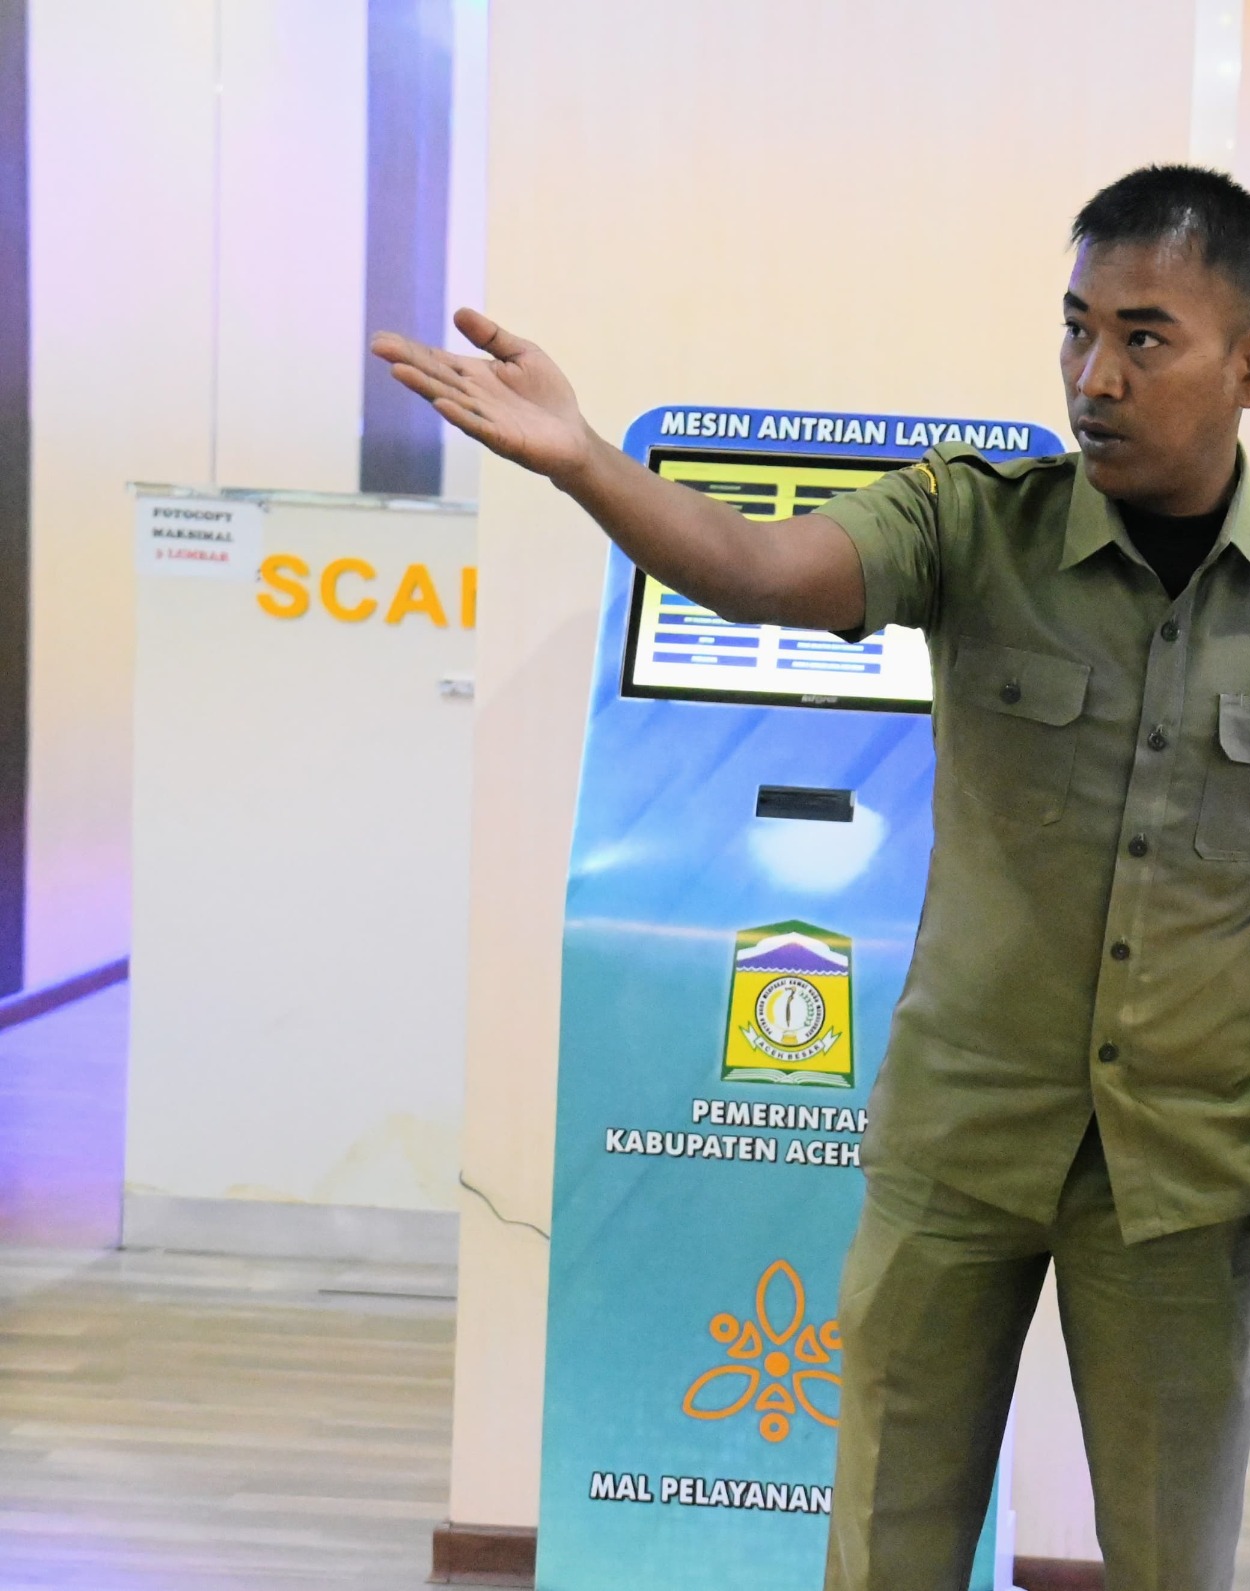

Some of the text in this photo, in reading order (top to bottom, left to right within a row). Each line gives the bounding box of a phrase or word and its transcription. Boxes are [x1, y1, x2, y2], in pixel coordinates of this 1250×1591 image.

[660, 411, 1030, 452] MESIN ANTRIAN LAYANAN
[152, 506, 233, 522] FOTOCOPY
[152, 527, 234, 542] MAKSIMAL
[168, 548, 229, 562] LEMBAR
[759, 1041, 821, 1060] ACEH BESAR
[605, 1128, 861, 1168] KABUPATEN ACEH
[590, 1472, 833, 1514] MAL PELAYANAN
